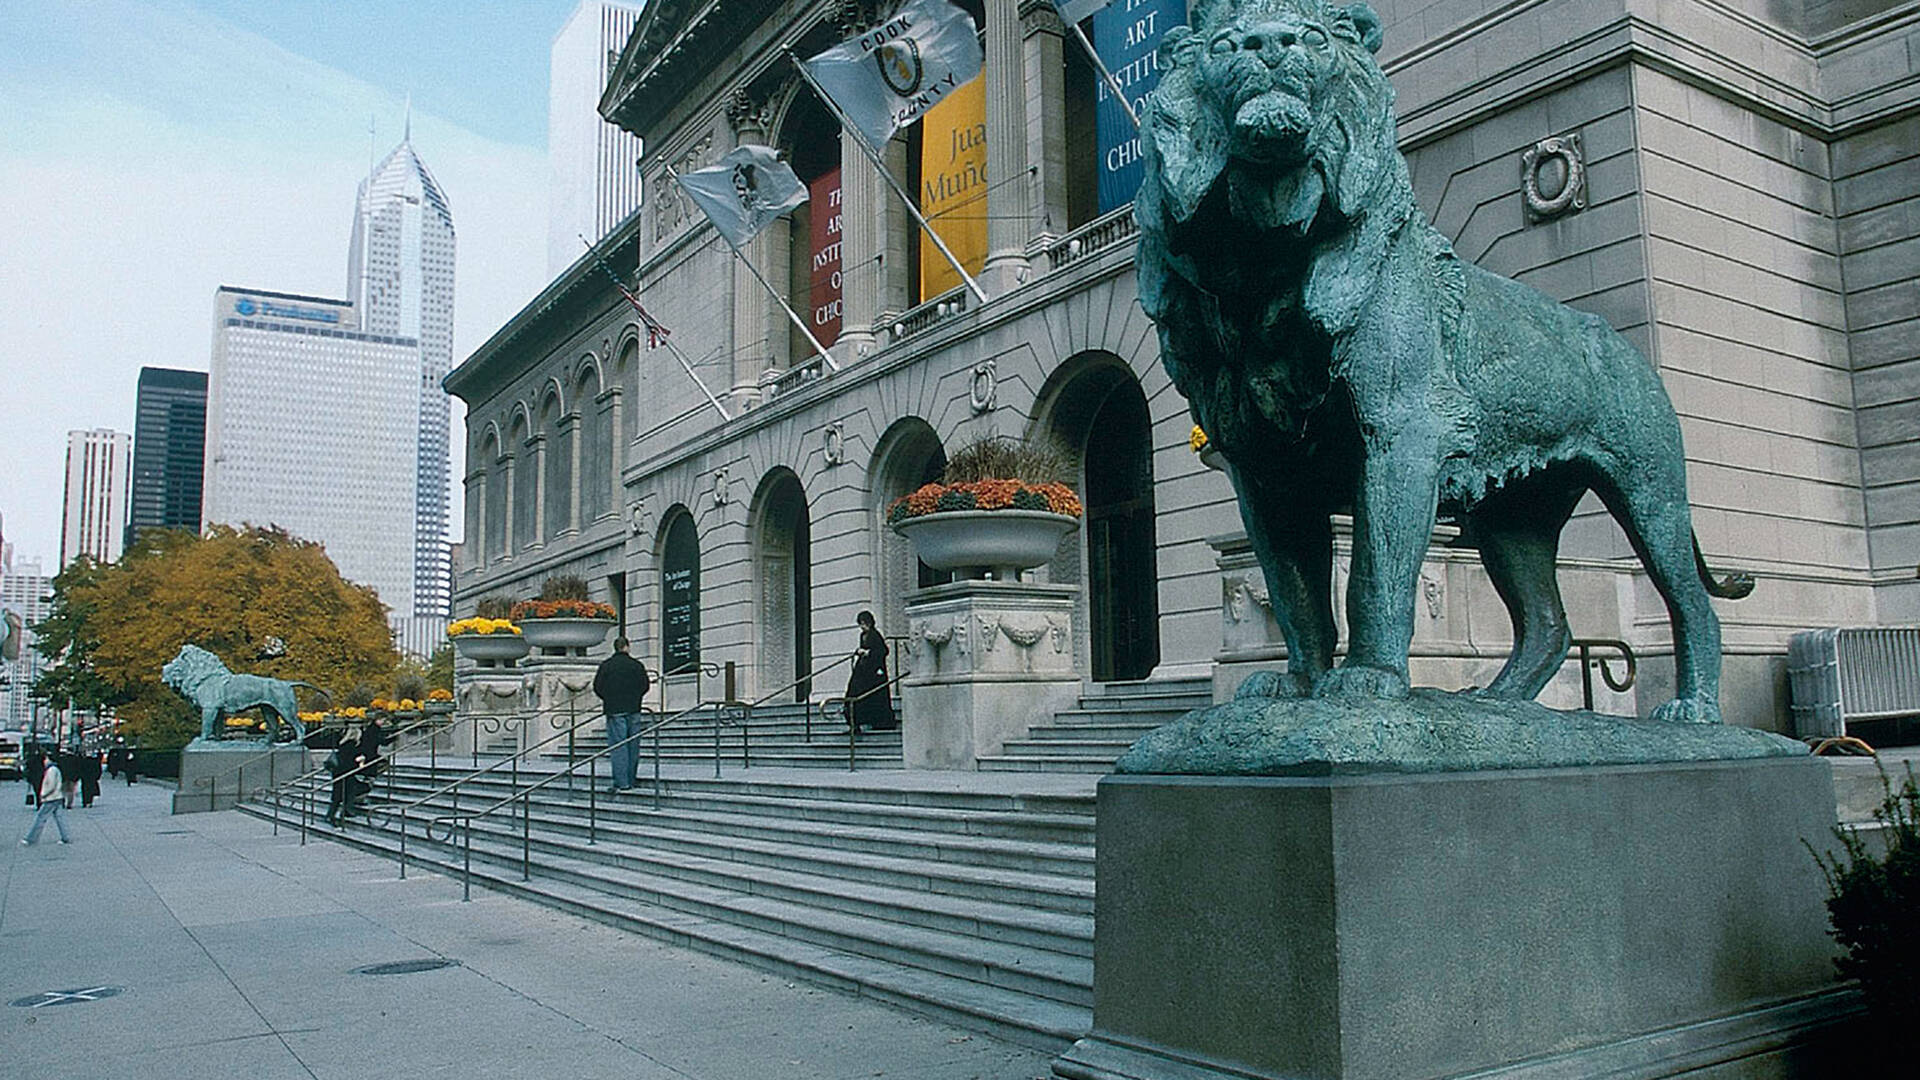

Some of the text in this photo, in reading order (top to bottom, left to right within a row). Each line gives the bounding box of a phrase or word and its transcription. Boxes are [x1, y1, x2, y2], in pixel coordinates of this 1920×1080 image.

[860, 16, 912, 52] COOK
[1124, 10, 1158, 50] ART
[950, 123, 987, 165] Jua
